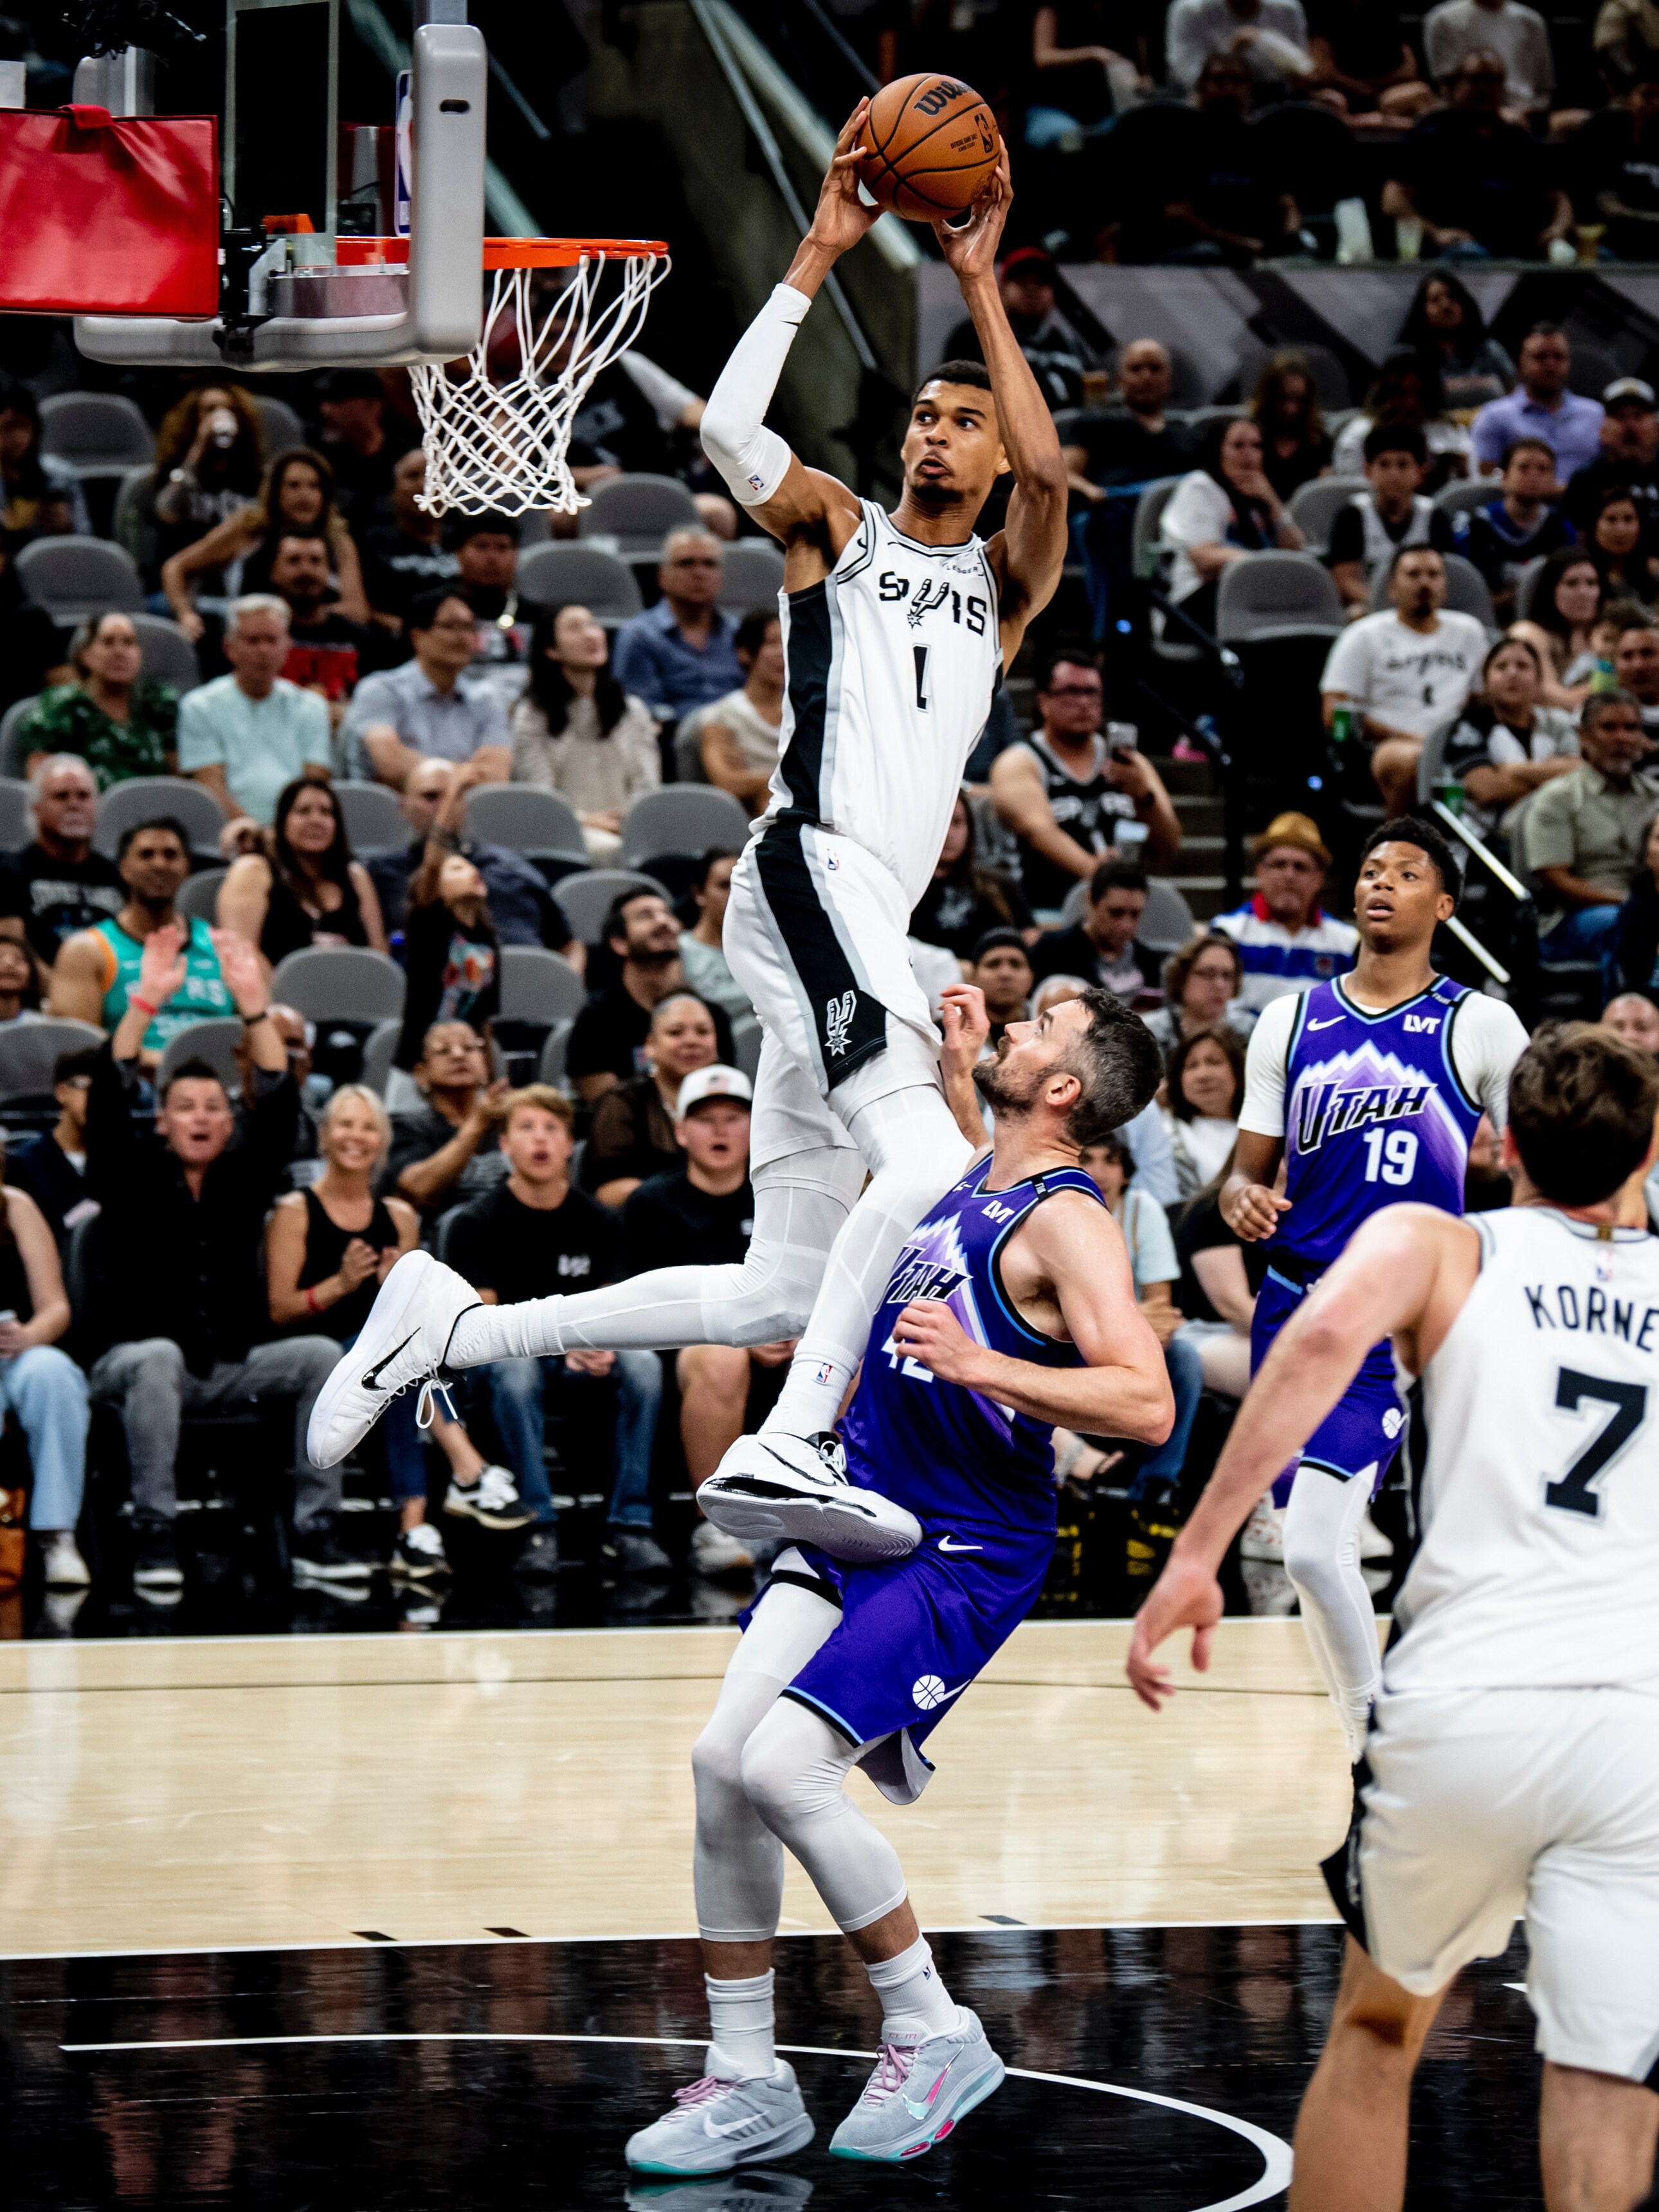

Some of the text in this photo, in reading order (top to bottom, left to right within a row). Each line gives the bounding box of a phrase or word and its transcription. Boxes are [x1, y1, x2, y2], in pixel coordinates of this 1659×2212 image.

[912, 80, 970, 117] Wil
[947, 565, 978, 574] LEDGER
[912, 643, 932, 714] 1
[1403, 1014, 1442, 1034] LVT
[1297, 1079, 1438, 1156] UTAH
[1363, 1127, 1419, 1186] 19
[981, 1200, 1015, 1224] LVT
[1542, 1360, 1653, 1524] 7
